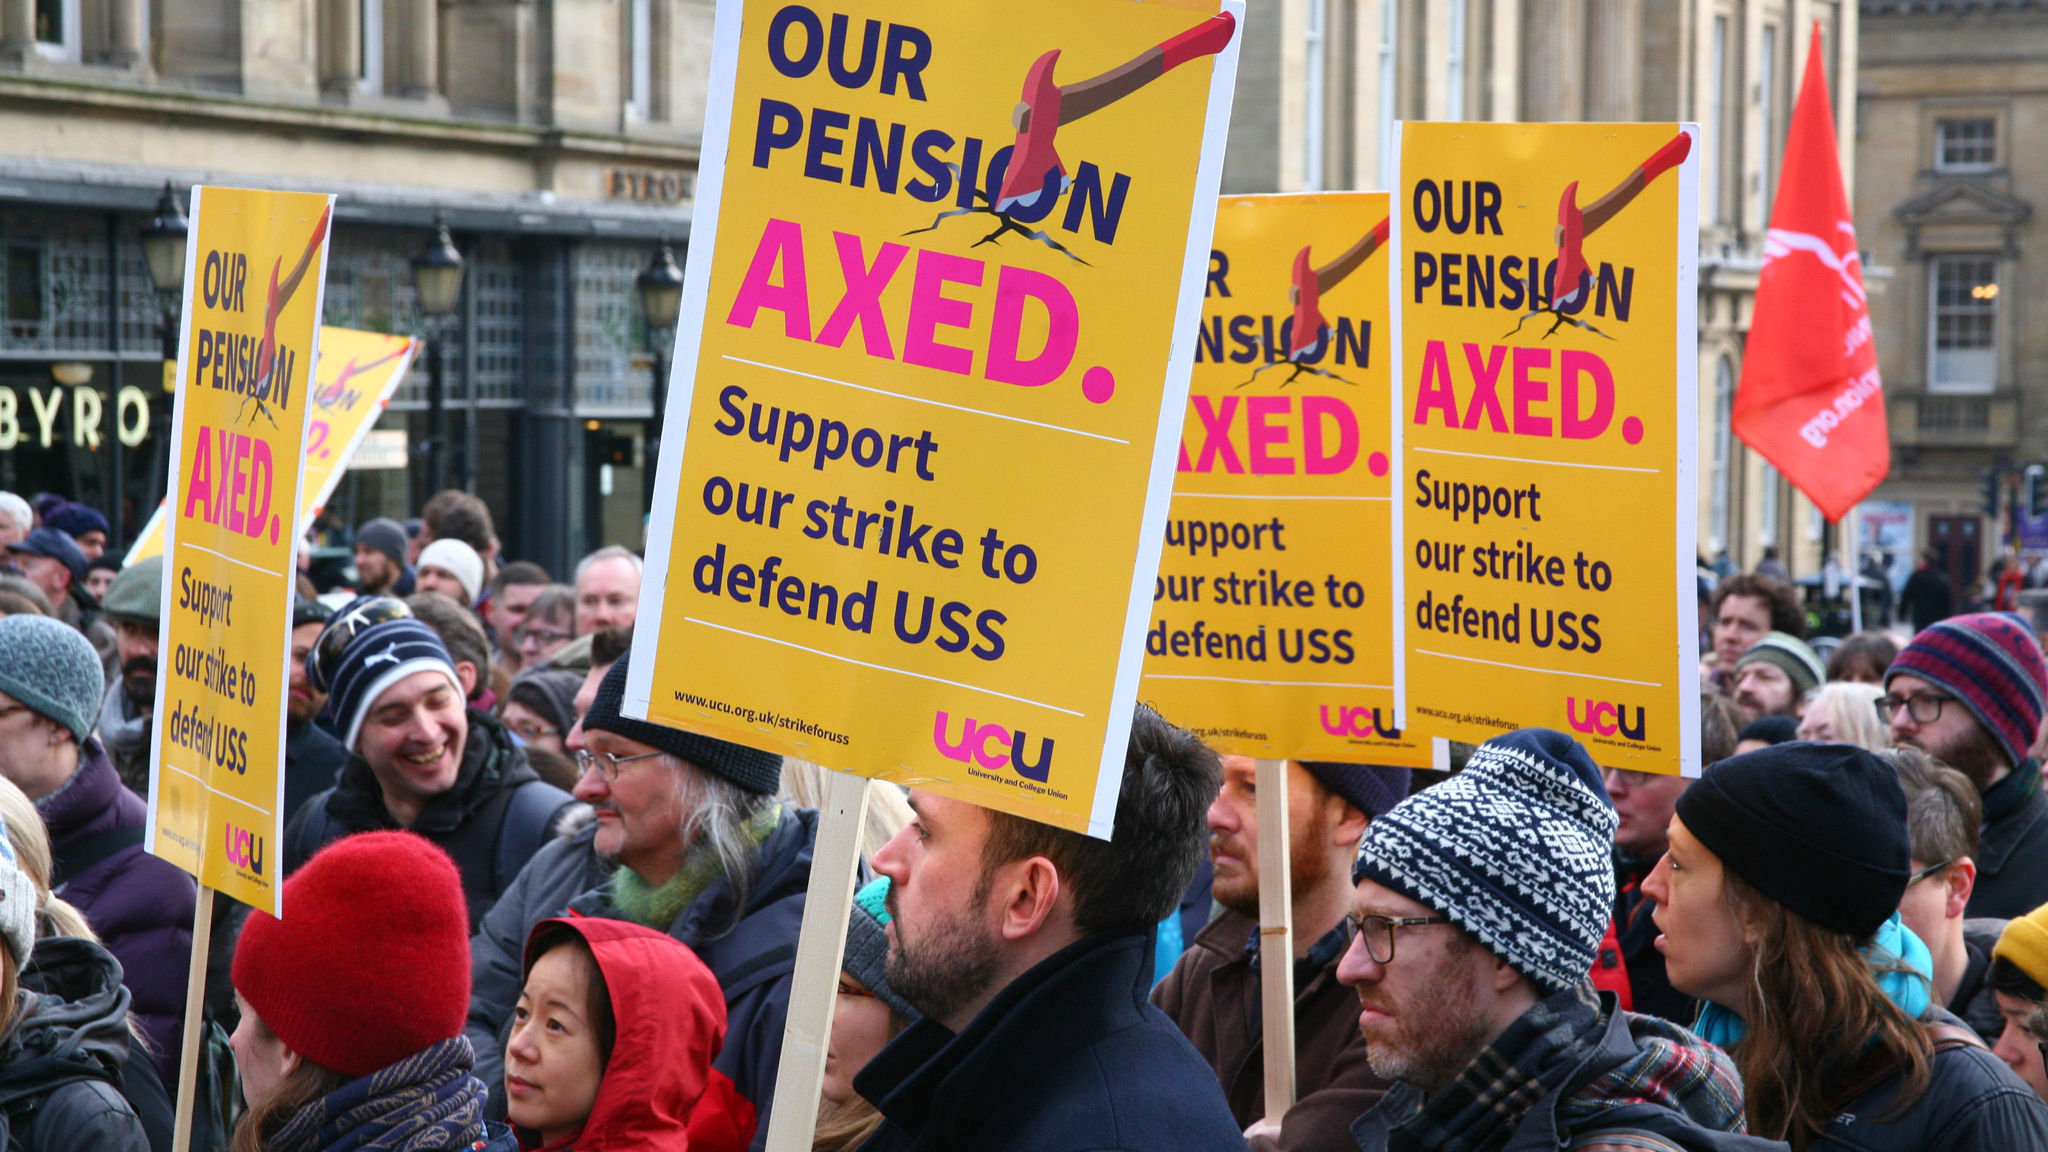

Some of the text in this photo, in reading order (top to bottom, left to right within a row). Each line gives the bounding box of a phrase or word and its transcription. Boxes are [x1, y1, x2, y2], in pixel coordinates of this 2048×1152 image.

[767, 5, 932, 101] OUR
[753, 98, 1131, 245] PENSION
[1413, 178, 1504, 236] OUR
[203, 250, 247, 313] OUR
[726, 218, 1115, 404] AXED.
[1413, 251, 1635, 322] PENSION
[196, 328, 295, 411] PENSION
[1195, 315, 1371, 369] NSION
[1413, 339, 1644, 445] AXED.
[714, 385, 938, 481] Support
[184, 426, 280, 546] AXED.
[1415, 469, 1541, 524] Support
[703, 477, 1037, 584] our strike to
[1165, 517, 1286, 557] upport
[1214, 569, 1315, 608] strike
[1325, 573, 1365, 609] to
[1415, 538, 1612, 592] our strike to
[180, 567, 232, 628] Support
[693, 543, 1008, 661] defend USS
[1416, 591, 1602, 654] defend USS
[1146, 619, 1356, 666] defend USS
[175, 643, 255, 707] our strike to
[170, 700, 247, 776] defend USS
[674, 690, 850, 745] www.ucu.org.uk/strikeforuss
[968, 768, 1068, 800] University and College Union
